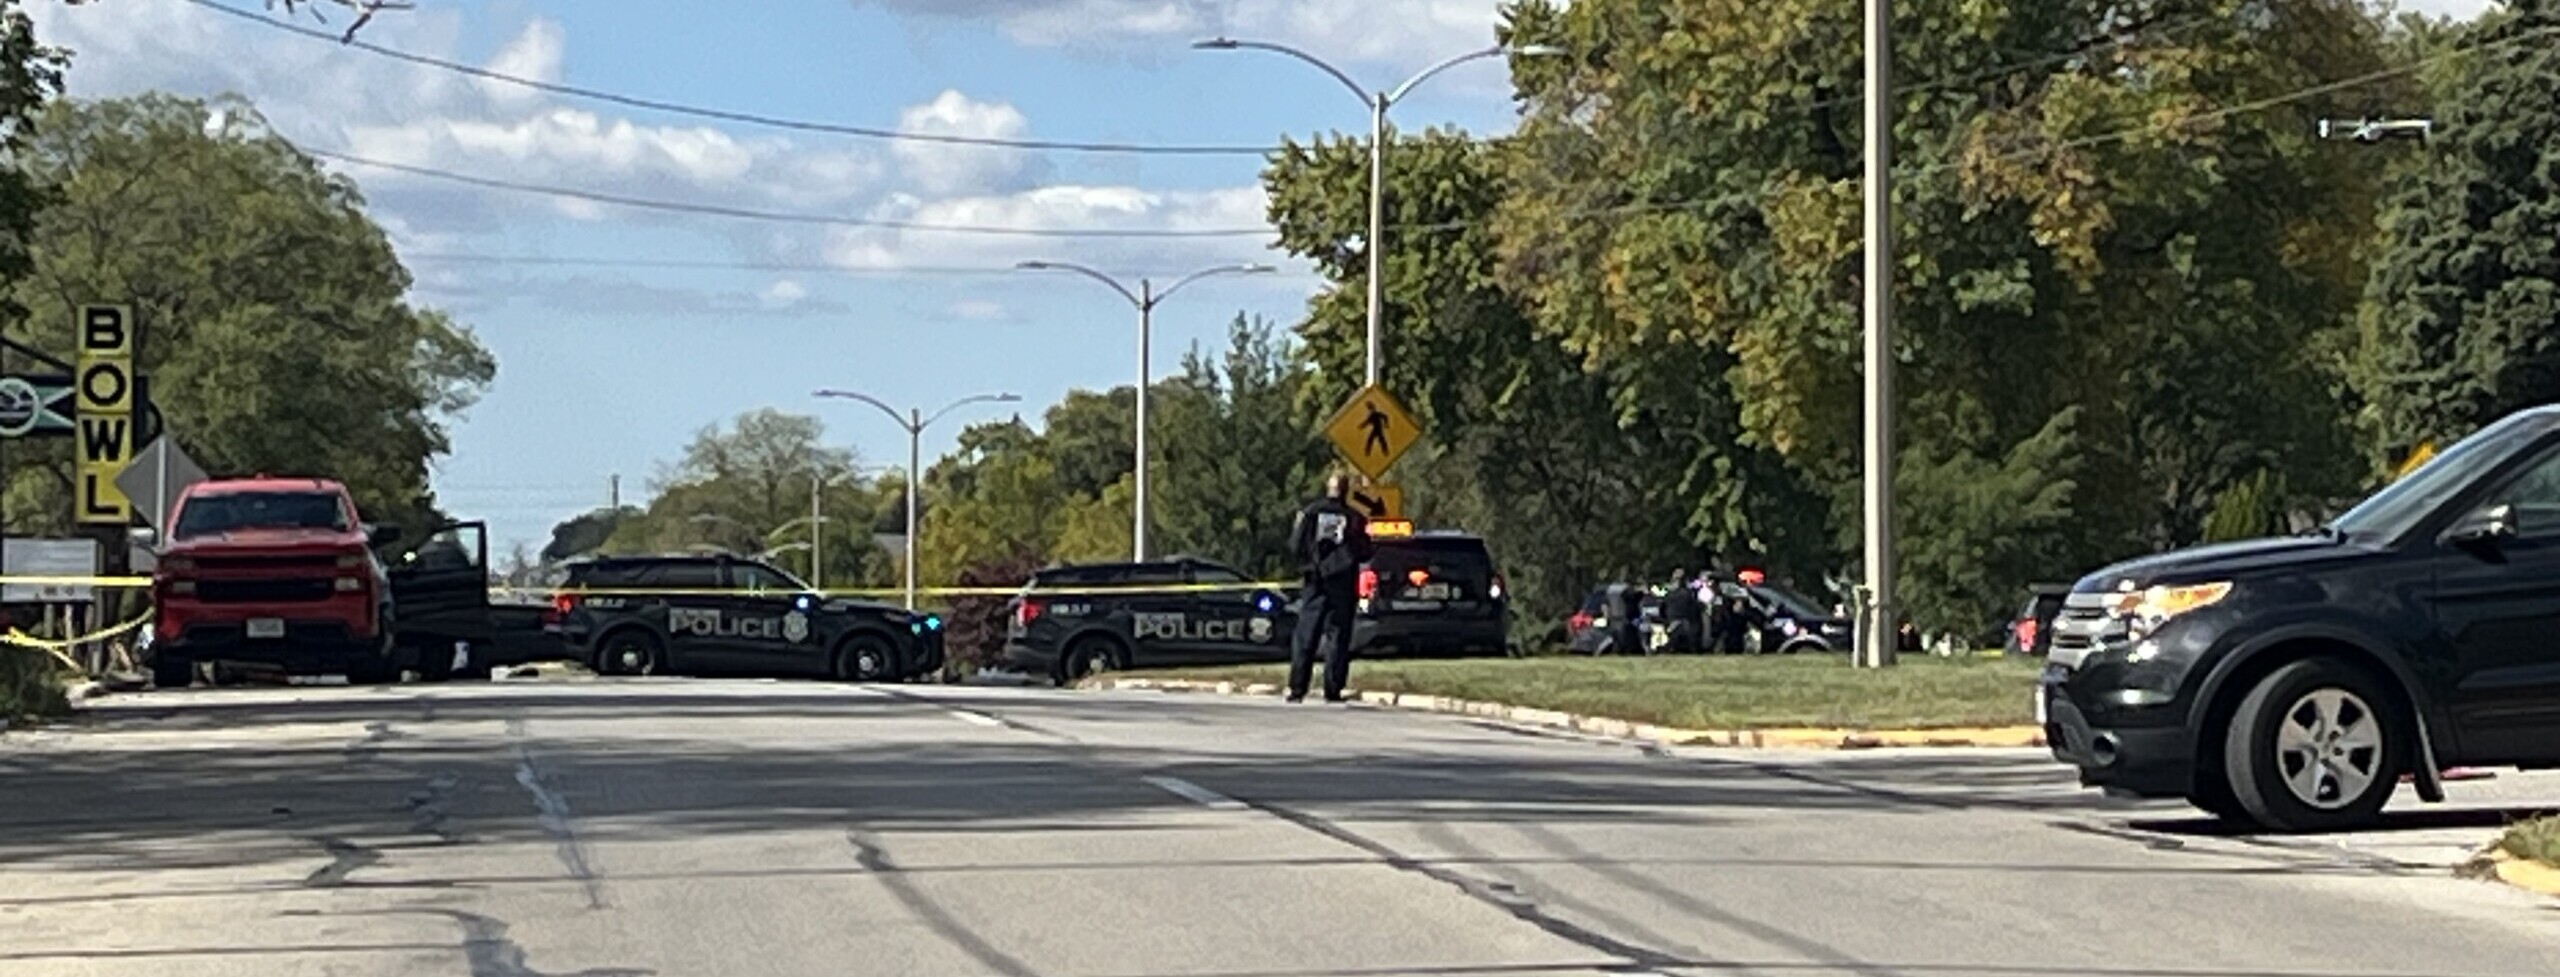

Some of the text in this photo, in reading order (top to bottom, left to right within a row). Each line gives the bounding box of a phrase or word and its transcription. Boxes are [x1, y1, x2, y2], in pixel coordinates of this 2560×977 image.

[82, 307, 127, 516] BOWL
[669, 609, 781, 639] POLICE
[1134, 613, 1246, 641] POLICE
